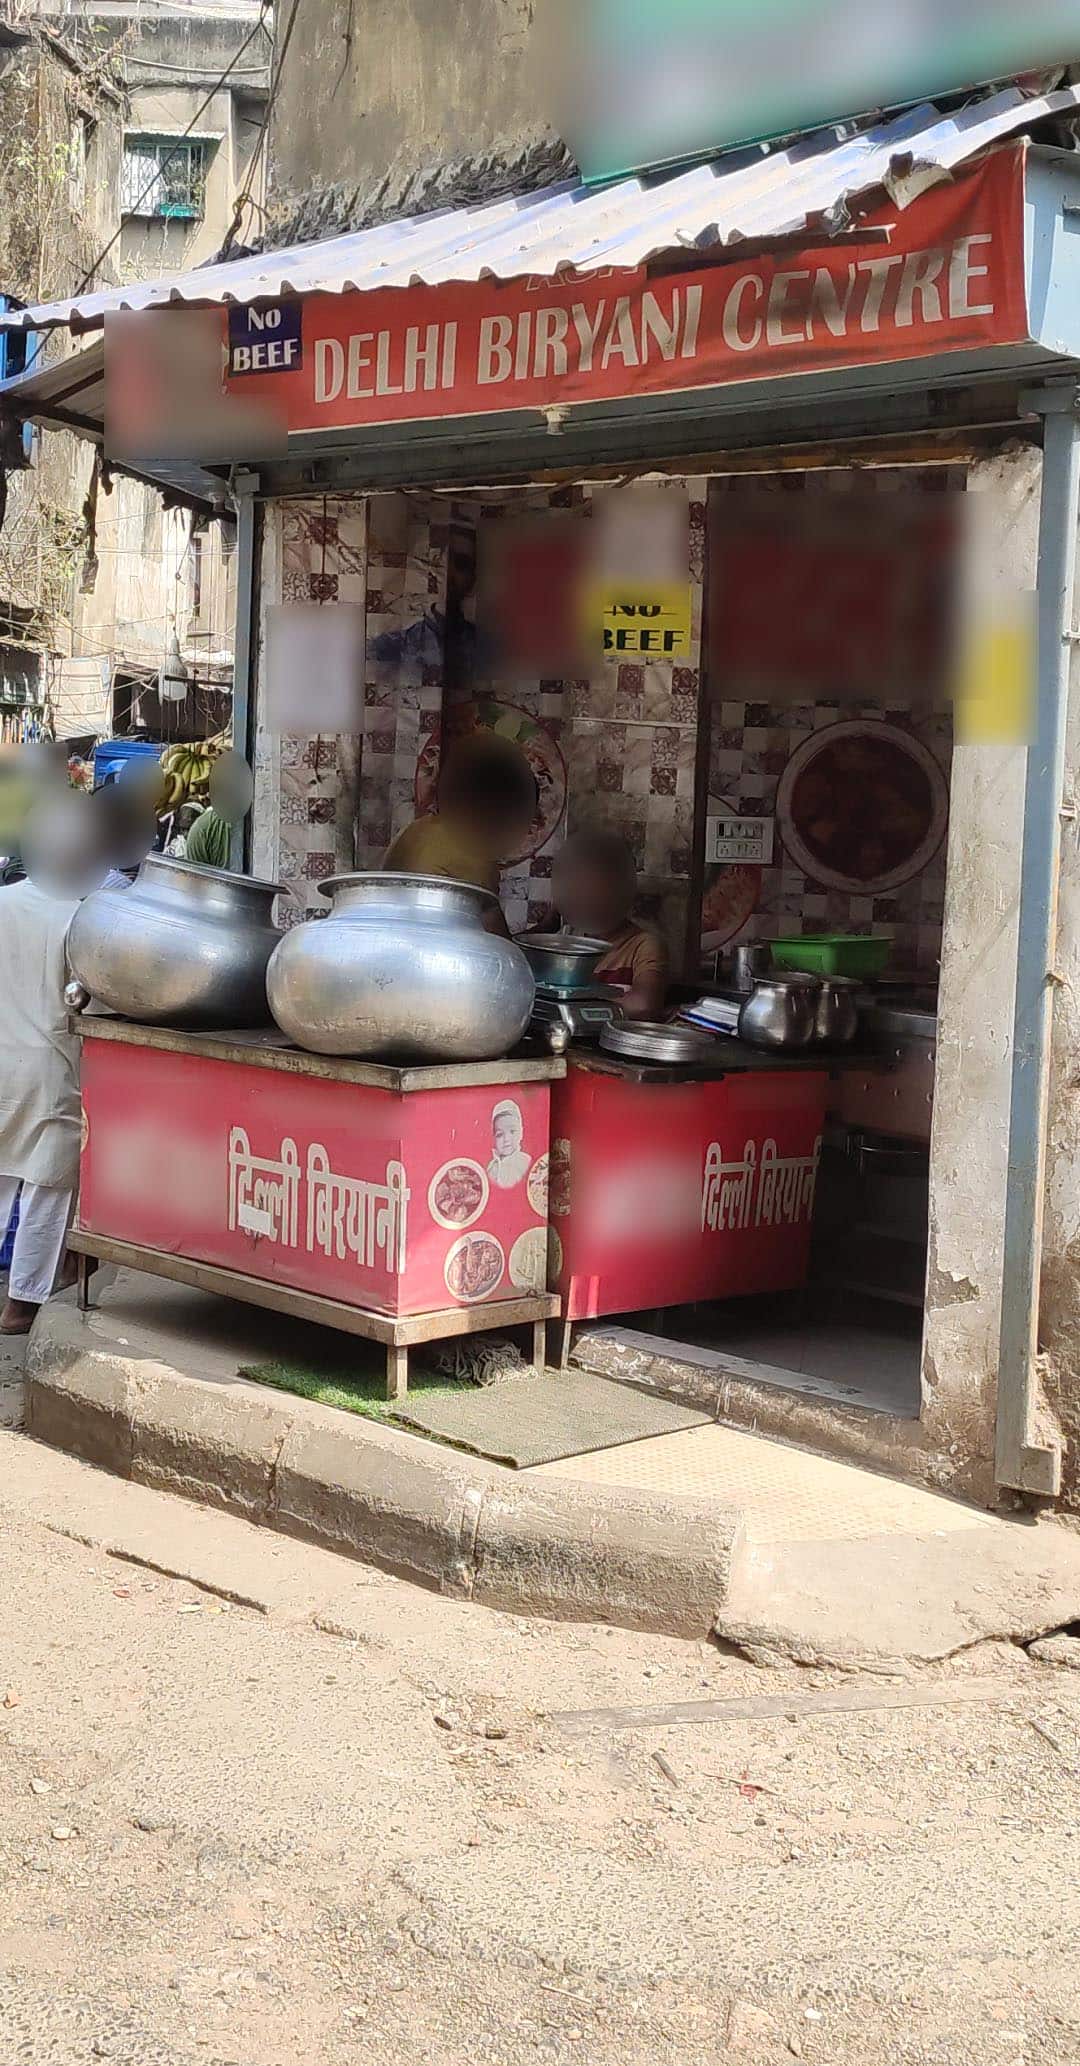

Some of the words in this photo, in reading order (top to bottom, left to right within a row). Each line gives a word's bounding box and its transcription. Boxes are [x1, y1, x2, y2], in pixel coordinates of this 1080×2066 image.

[233, 339, 298, 372] BEEF
[315, 322, 457, 403] DELHI
[477, 287, 703, 385] BIRYANI
[722, 234, 994, 352] CENTRE
[306, 1143, 411, 1274] बिरयानी
[702, 1142, 756, 1232] दिल्ली
